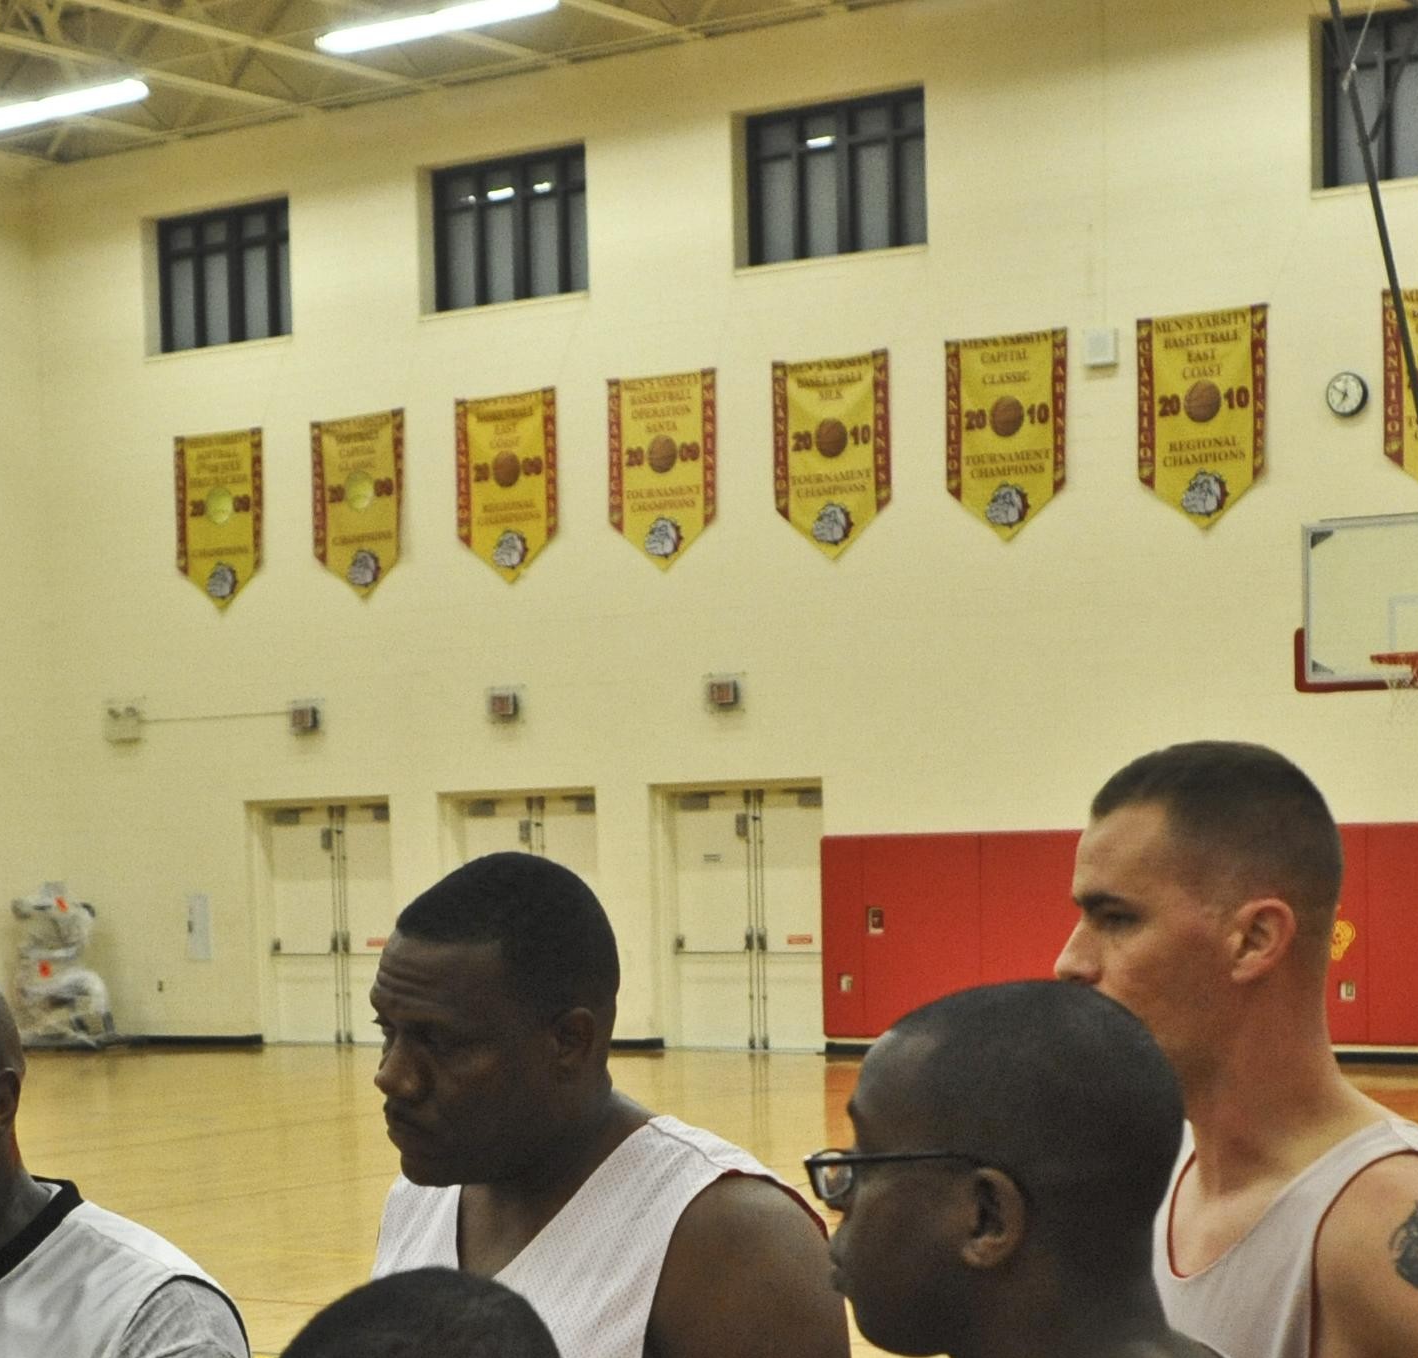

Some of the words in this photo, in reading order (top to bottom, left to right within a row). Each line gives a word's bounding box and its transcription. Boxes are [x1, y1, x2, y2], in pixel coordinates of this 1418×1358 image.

[1187, 350, 1217, 363] EAST
[1182, 364, 1223, 380] COAST
[1158, 394, 1180, 417] 20
[1224, 386, 1250, 410] 10
[965, 409, 987, 431] 20
[1027, 403, 1050, 425] 10
[1169, 435, 1237, 452] REGIONAL
[965, 448, 1051, 466] TOURNAMENT
[1163, 451, 1246, 468] CHAMPIONS
[970, 462, 1046, 479] CHAMPIONS
